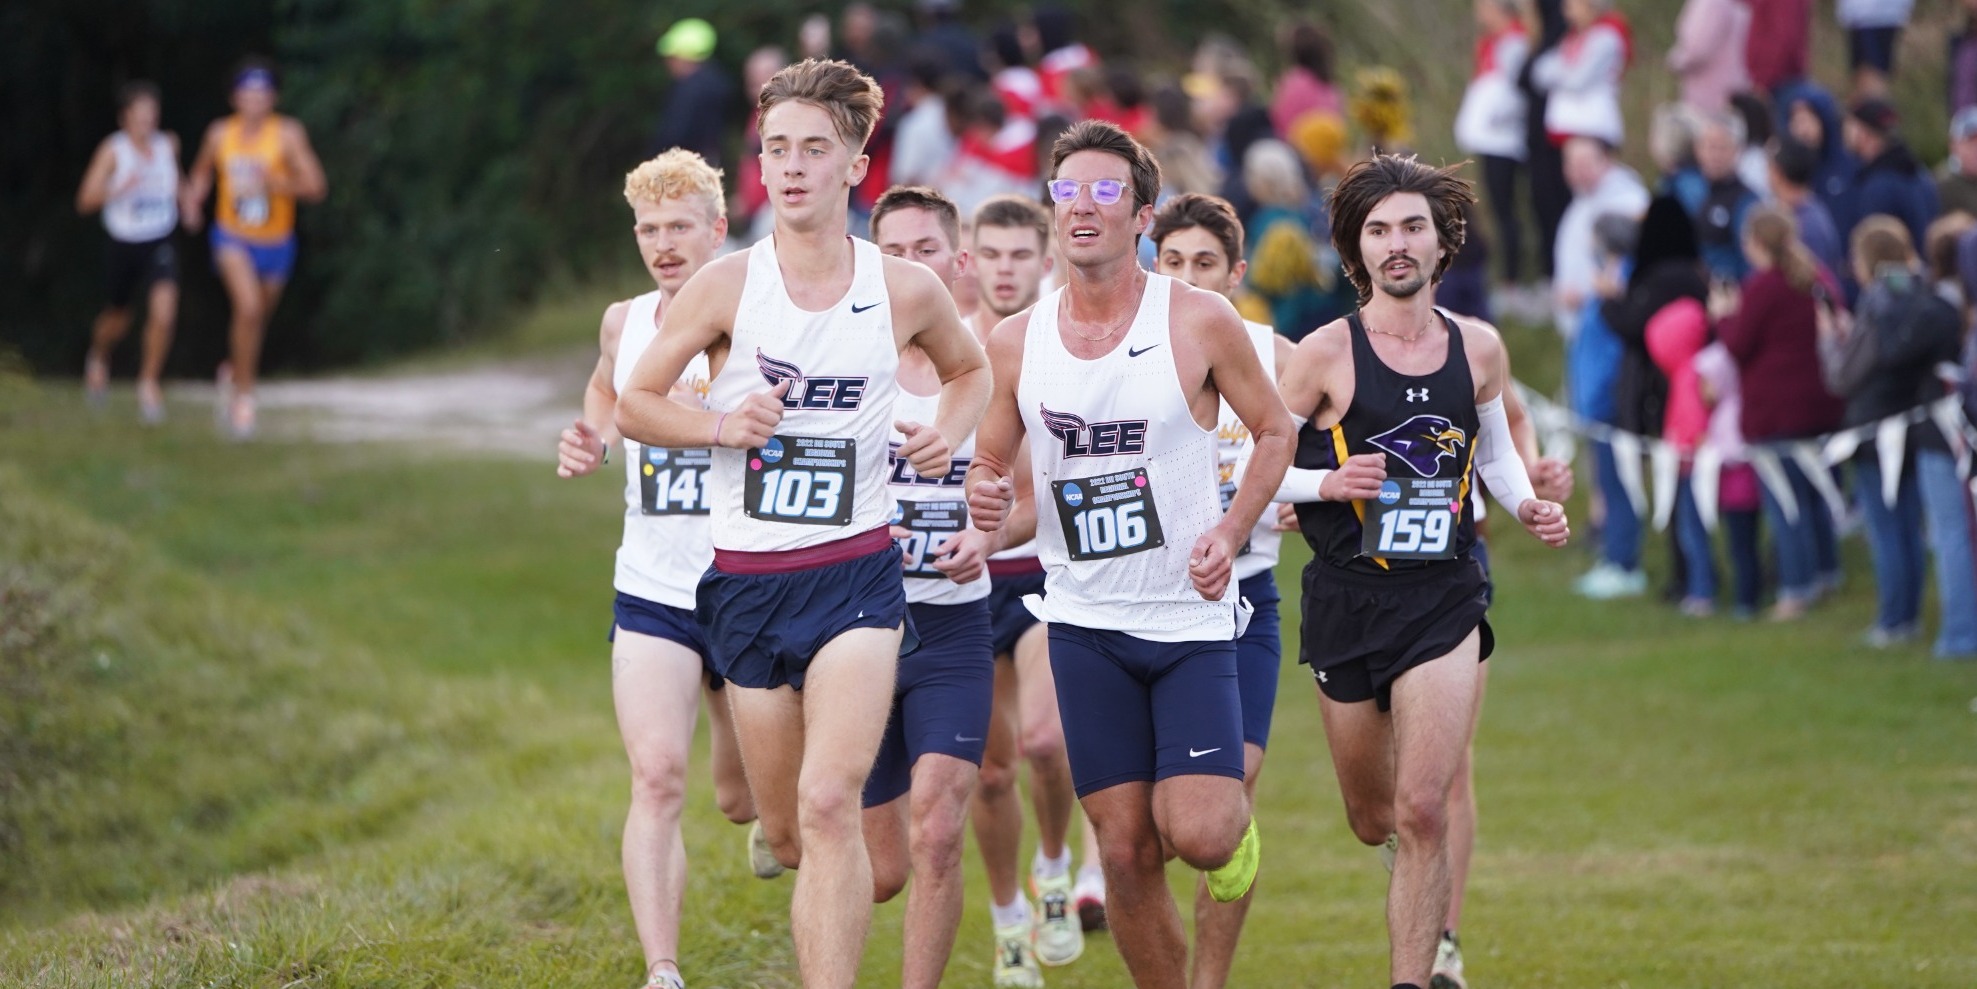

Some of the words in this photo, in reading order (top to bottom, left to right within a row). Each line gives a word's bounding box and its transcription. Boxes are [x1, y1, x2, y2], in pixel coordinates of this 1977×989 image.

[777, 376, 869, 411] LEE
[761, 448, 783, 458] NCAA
[1062, 419, 1148, 460] LEE
[888, 458, 974, 488] LE
[758, 468, 844, 519] 103
[1066, 493, 1084, 501] NCAA
[1380, 491, 1400, 499] NCAA
[1073, 501, 1148, 554] 106
[1377, 509, 1452, 553] 159
[895, 530, 958, 572] 05
